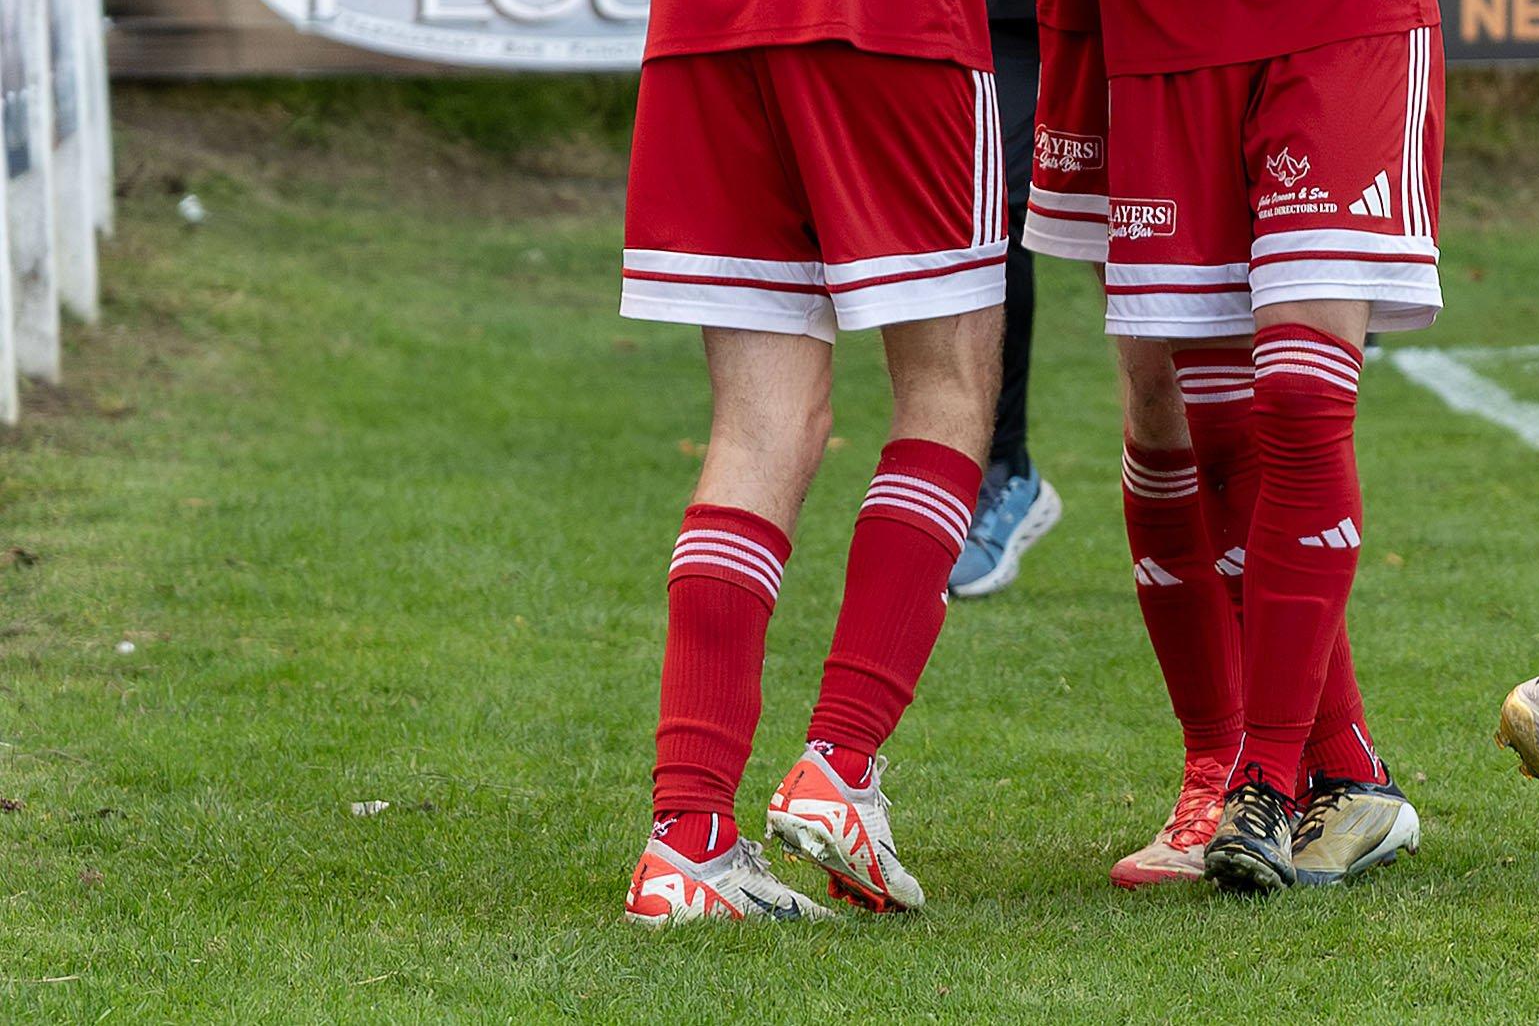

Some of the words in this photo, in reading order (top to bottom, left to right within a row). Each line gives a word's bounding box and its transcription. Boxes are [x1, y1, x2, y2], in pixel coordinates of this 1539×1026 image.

[1298, 186, 1307, 200] &
[1274, 203, 1318, 216] DIRECTORS
[1319, 202, 1338, 214] LTD
